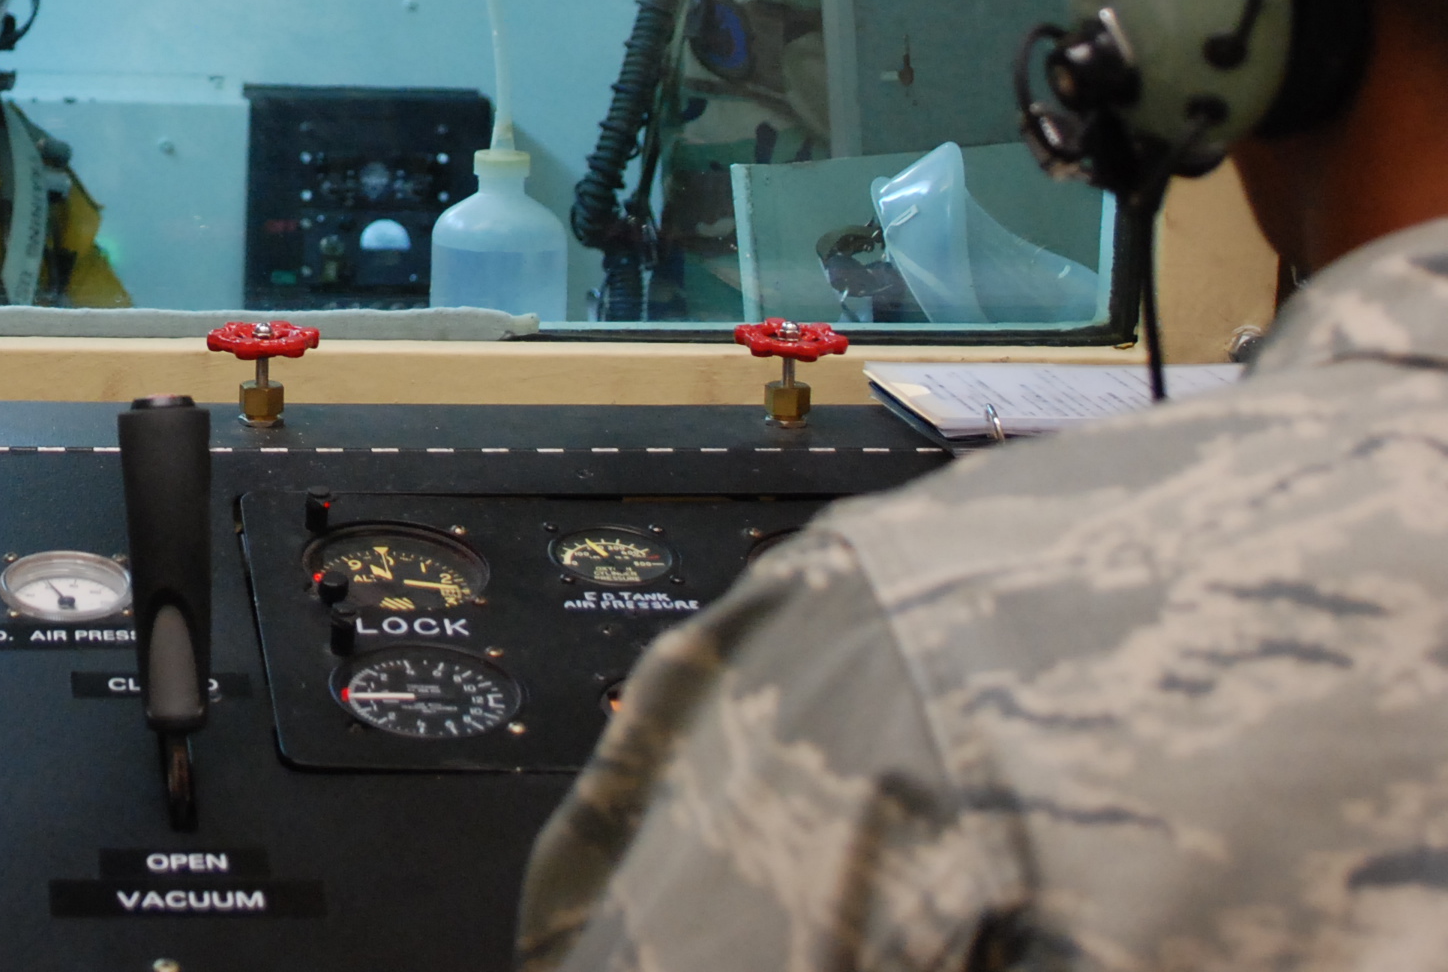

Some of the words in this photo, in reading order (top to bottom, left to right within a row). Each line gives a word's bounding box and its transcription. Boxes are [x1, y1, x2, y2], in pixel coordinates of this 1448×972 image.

[619, 591, 672, 602] TANK
[564, 600, 597, 609] AIR
[600, 600, 700, 610] PRESSURE
[355, 616, 470, 637] LOCK
[30, 630, 67, 641] AIR
[146, 853, 229, 871] OPEN
[117, 890, 266, 910] VACUUM
